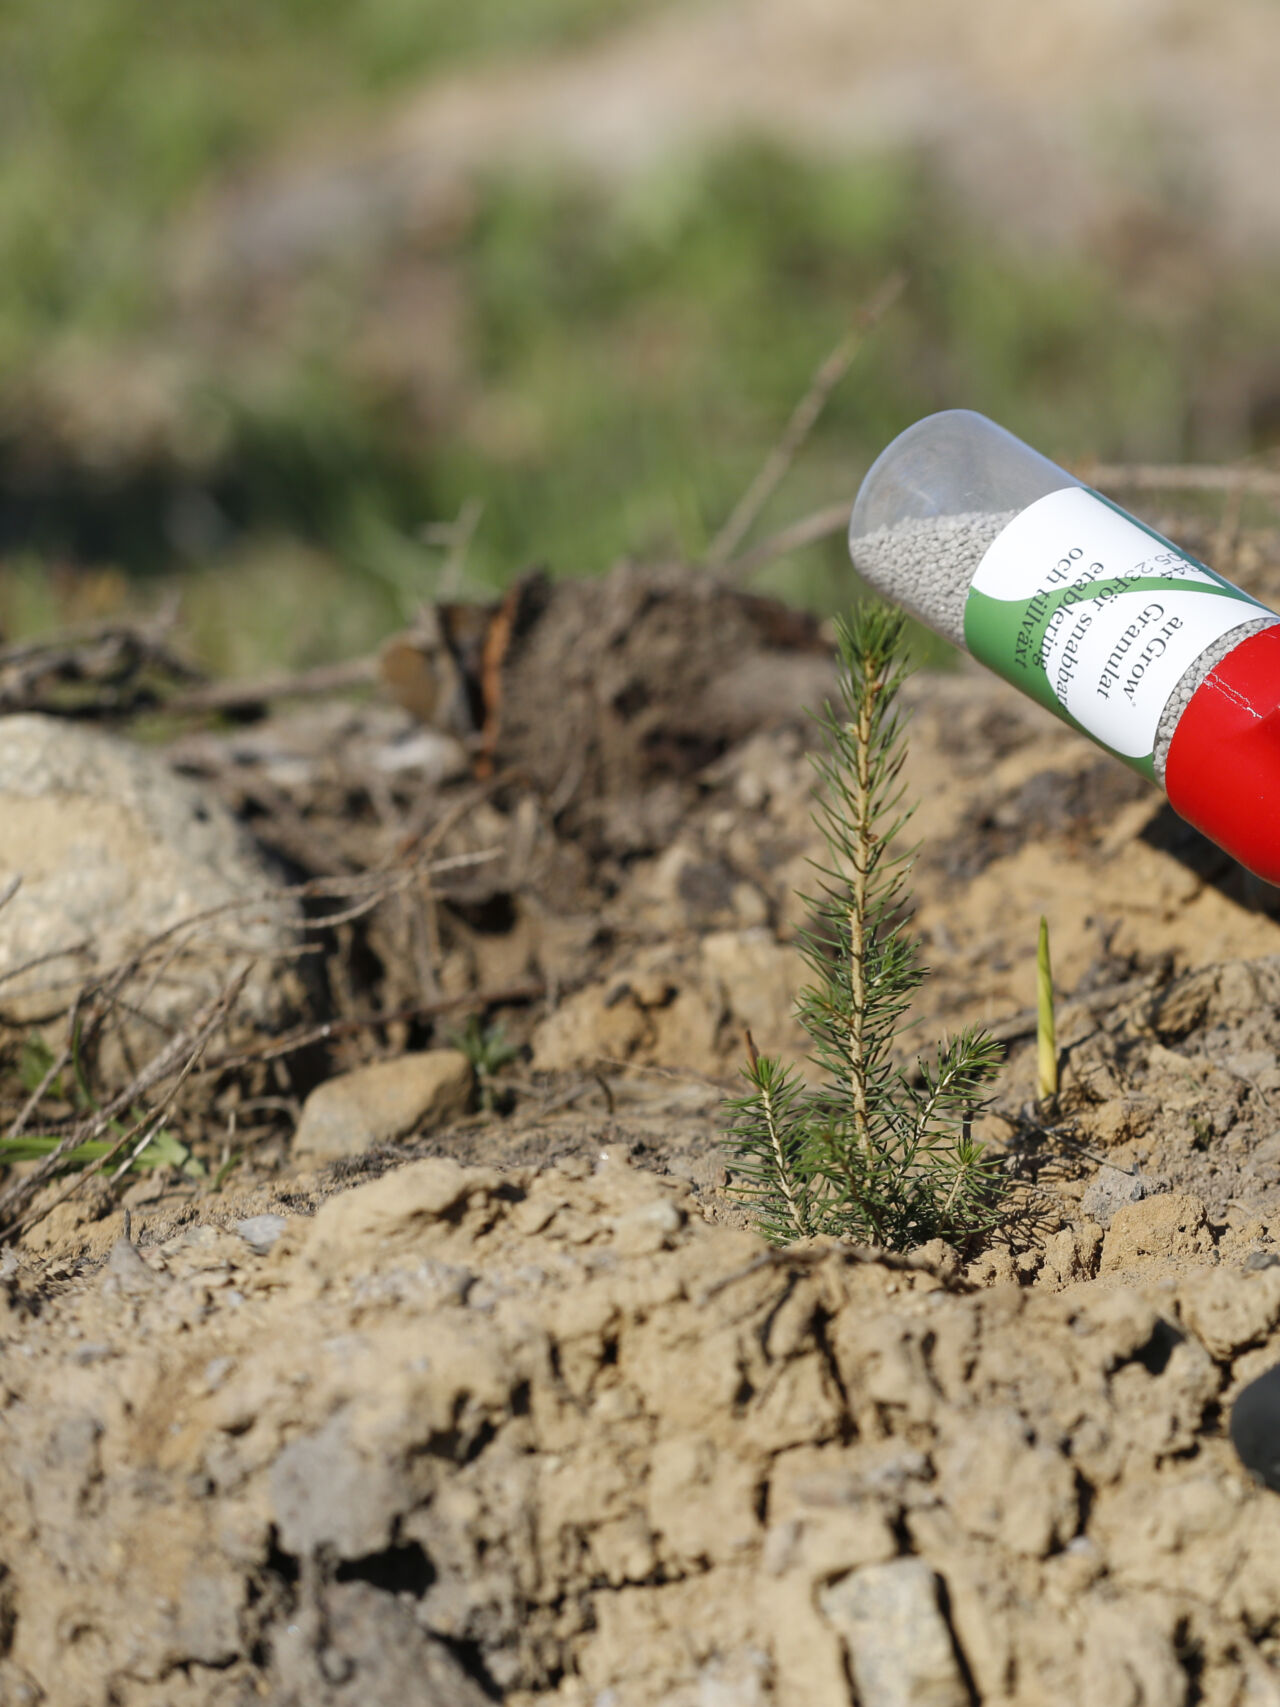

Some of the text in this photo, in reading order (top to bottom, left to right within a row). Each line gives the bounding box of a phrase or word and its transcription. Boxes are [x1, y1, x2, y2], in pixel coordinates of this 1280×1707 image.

[1014, 547, 1084, 669] och tillväxt
[1032, 562, 1105, 671] etablering
[1092, 574, 1131, 612] För
[1096, 603, 1165, 700] Granulat
